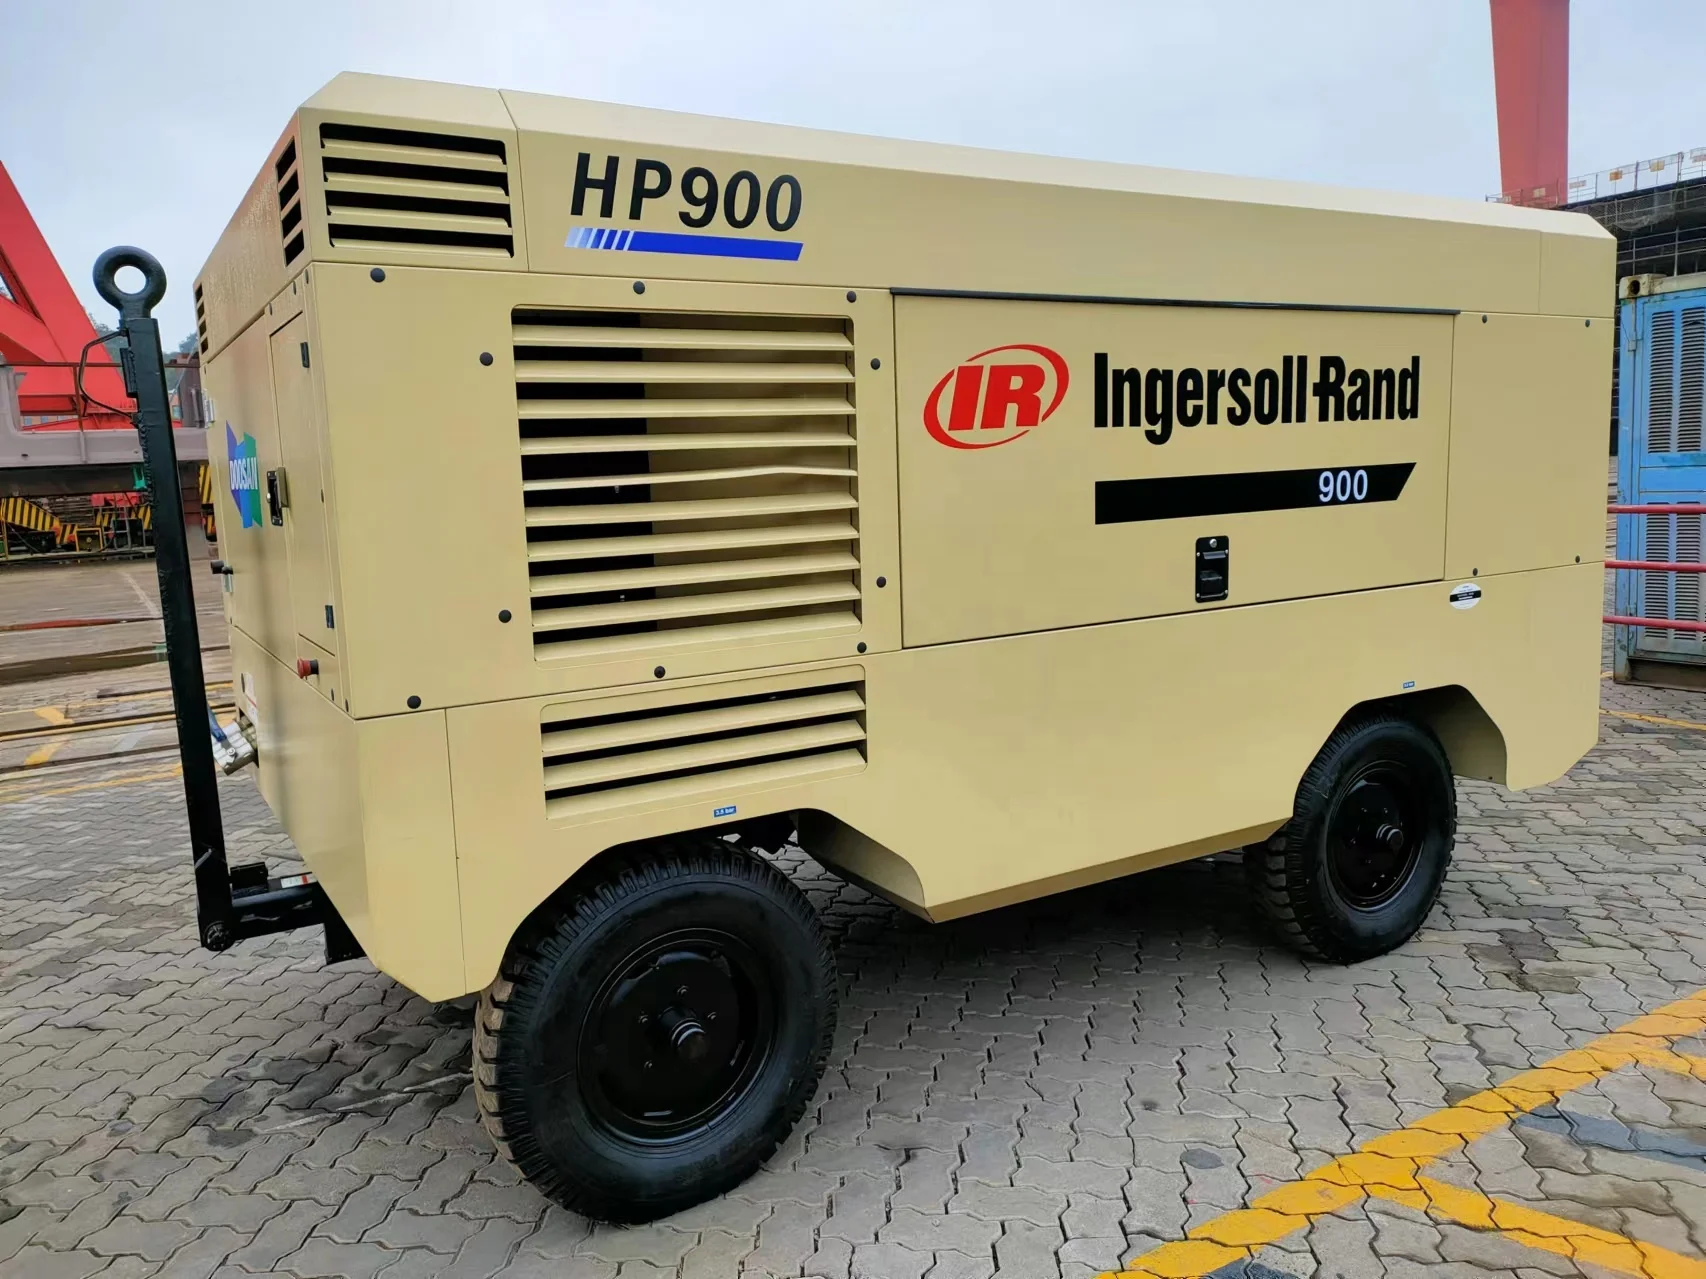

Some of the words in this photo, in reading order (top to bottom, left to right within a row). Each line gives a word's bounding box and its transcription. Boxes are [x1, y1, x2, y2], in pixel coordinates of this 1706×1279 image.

[570, 152, 802, 232] HP900
[948, 364, 1046, 431] IR
[229, 457, 259, 490] DOOSAN
[1318, 469, 1368, 502] 900
